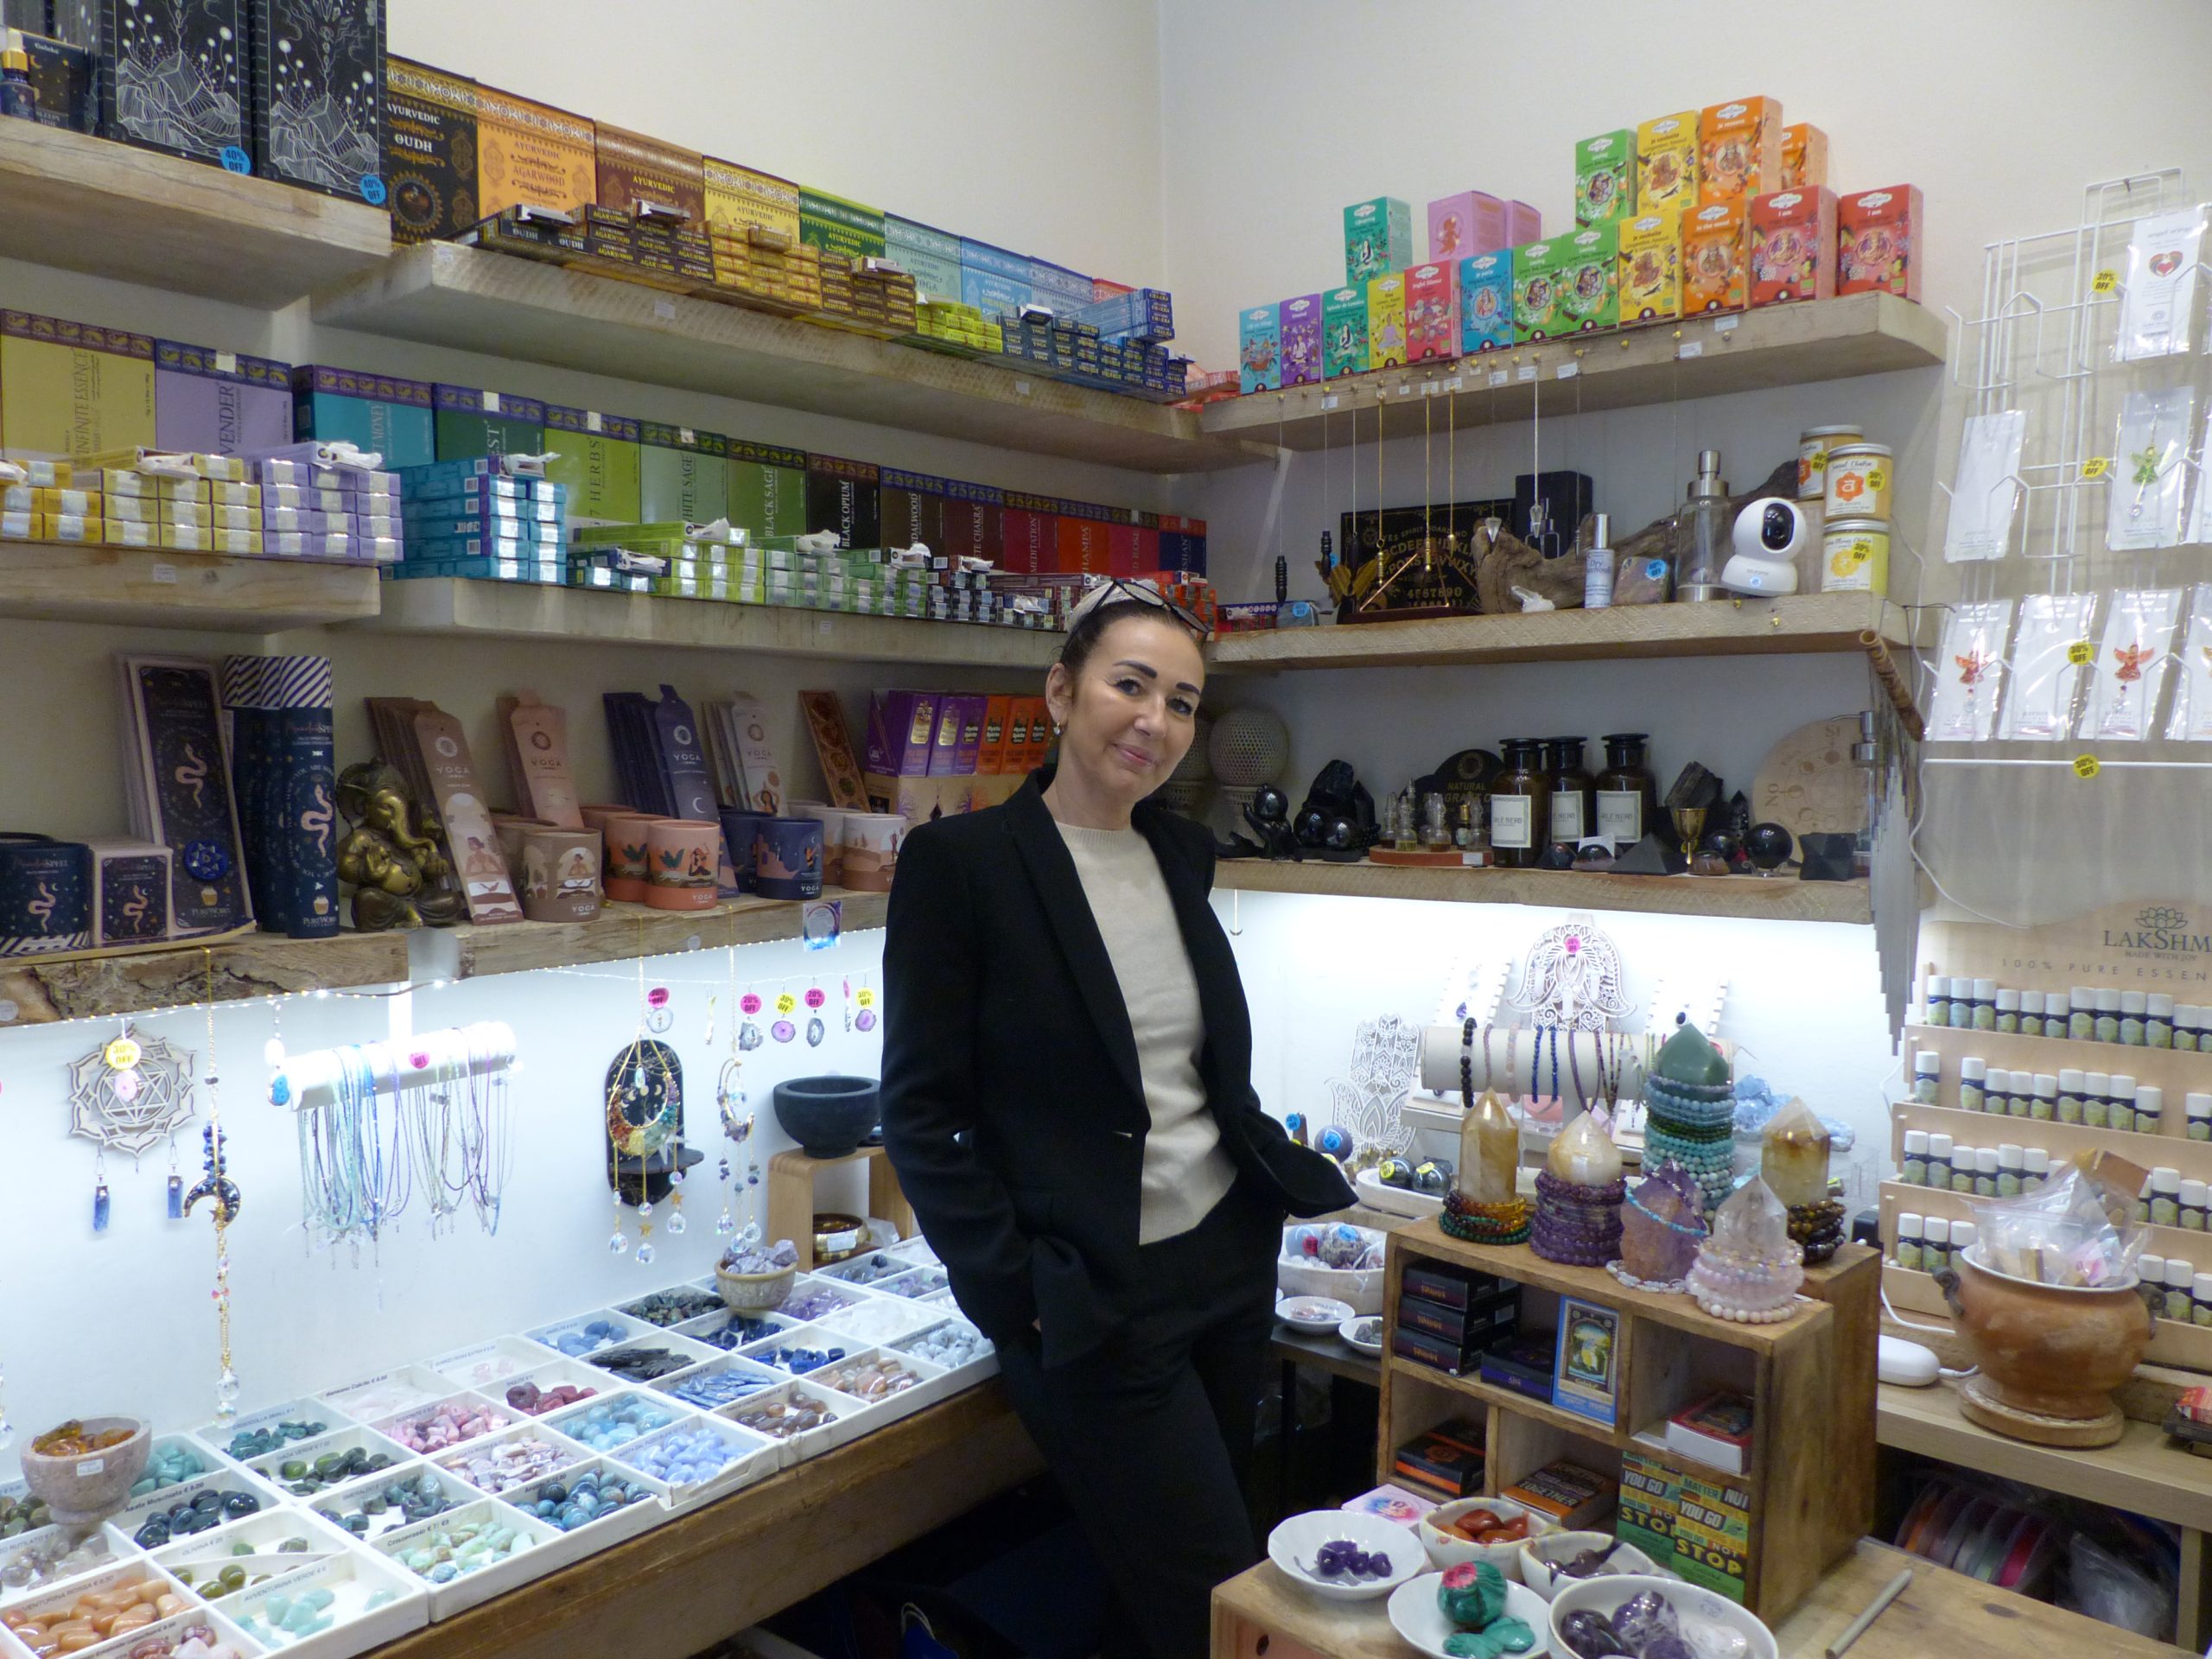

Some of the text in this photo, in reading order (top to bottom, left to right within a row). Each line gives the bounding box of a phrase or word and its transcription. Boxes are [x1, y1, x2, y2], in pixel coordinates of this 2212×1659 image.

[395, 133, 433, 152] OUDH
[226, 149, 245, 162] 40%
[515, 140, 561, 159] AYURVEDIC
[228, 160, 245, 173] OFF
[512, 166, 565, 187] AGARWOOD
[367, 188, 381, 200] OFF
[2094, 282, 2109, 290] OFF
[589, 439, 601, 502] HERBS
[682, 454, 693, 486] SAGE
[1870, 480, 1881, 488] OFF
[764, 465, 775, 537] BLACK SAGE
[841, 480, 850, 548] BLACK OPIUM
[973, 506, 982, 542] CHAKRA
[1029, 517, 1038, 575] MEDITATION
[1853, 551, 1866, 561] OFF
[2072, 654, 2088, 663] OFF
[531, 759, 562, 768] YOGA
[2075, 757, 2094, 769] 30%
[435, 766, 471, 775] YOGA
[2080, 766, 2095, 777] OFF
[1447, 782, 1486, 791] NATURAL
[572, 905, 595, 913] YOGA
[2103, 929, 2212, 953] LAKSHM
[2125, 950, 2199, 963] MADE WITH JOY
[2001, 957, 2208, 982] 100% PURE ESSEN
[652, 996, 664, 1005] OFF
[743, 995, 759, 1004] 20%
[781, 995, 794, 1005] 30%
[857, 990, 872, 999] 30%
[777, 1002, 790, 1013] OFF
[115, 1054, 134, 1065] OFF
[1624, 1470, 1664, 1495] YOU GO
[1518, 1479, 1581, 1507] TOGETHER
[1680, 1500, 1722, 1528] YOU GO
[1675, 1538, 1743, 1575] STOP
[1713, 1543, 1739, 1559] NOT
